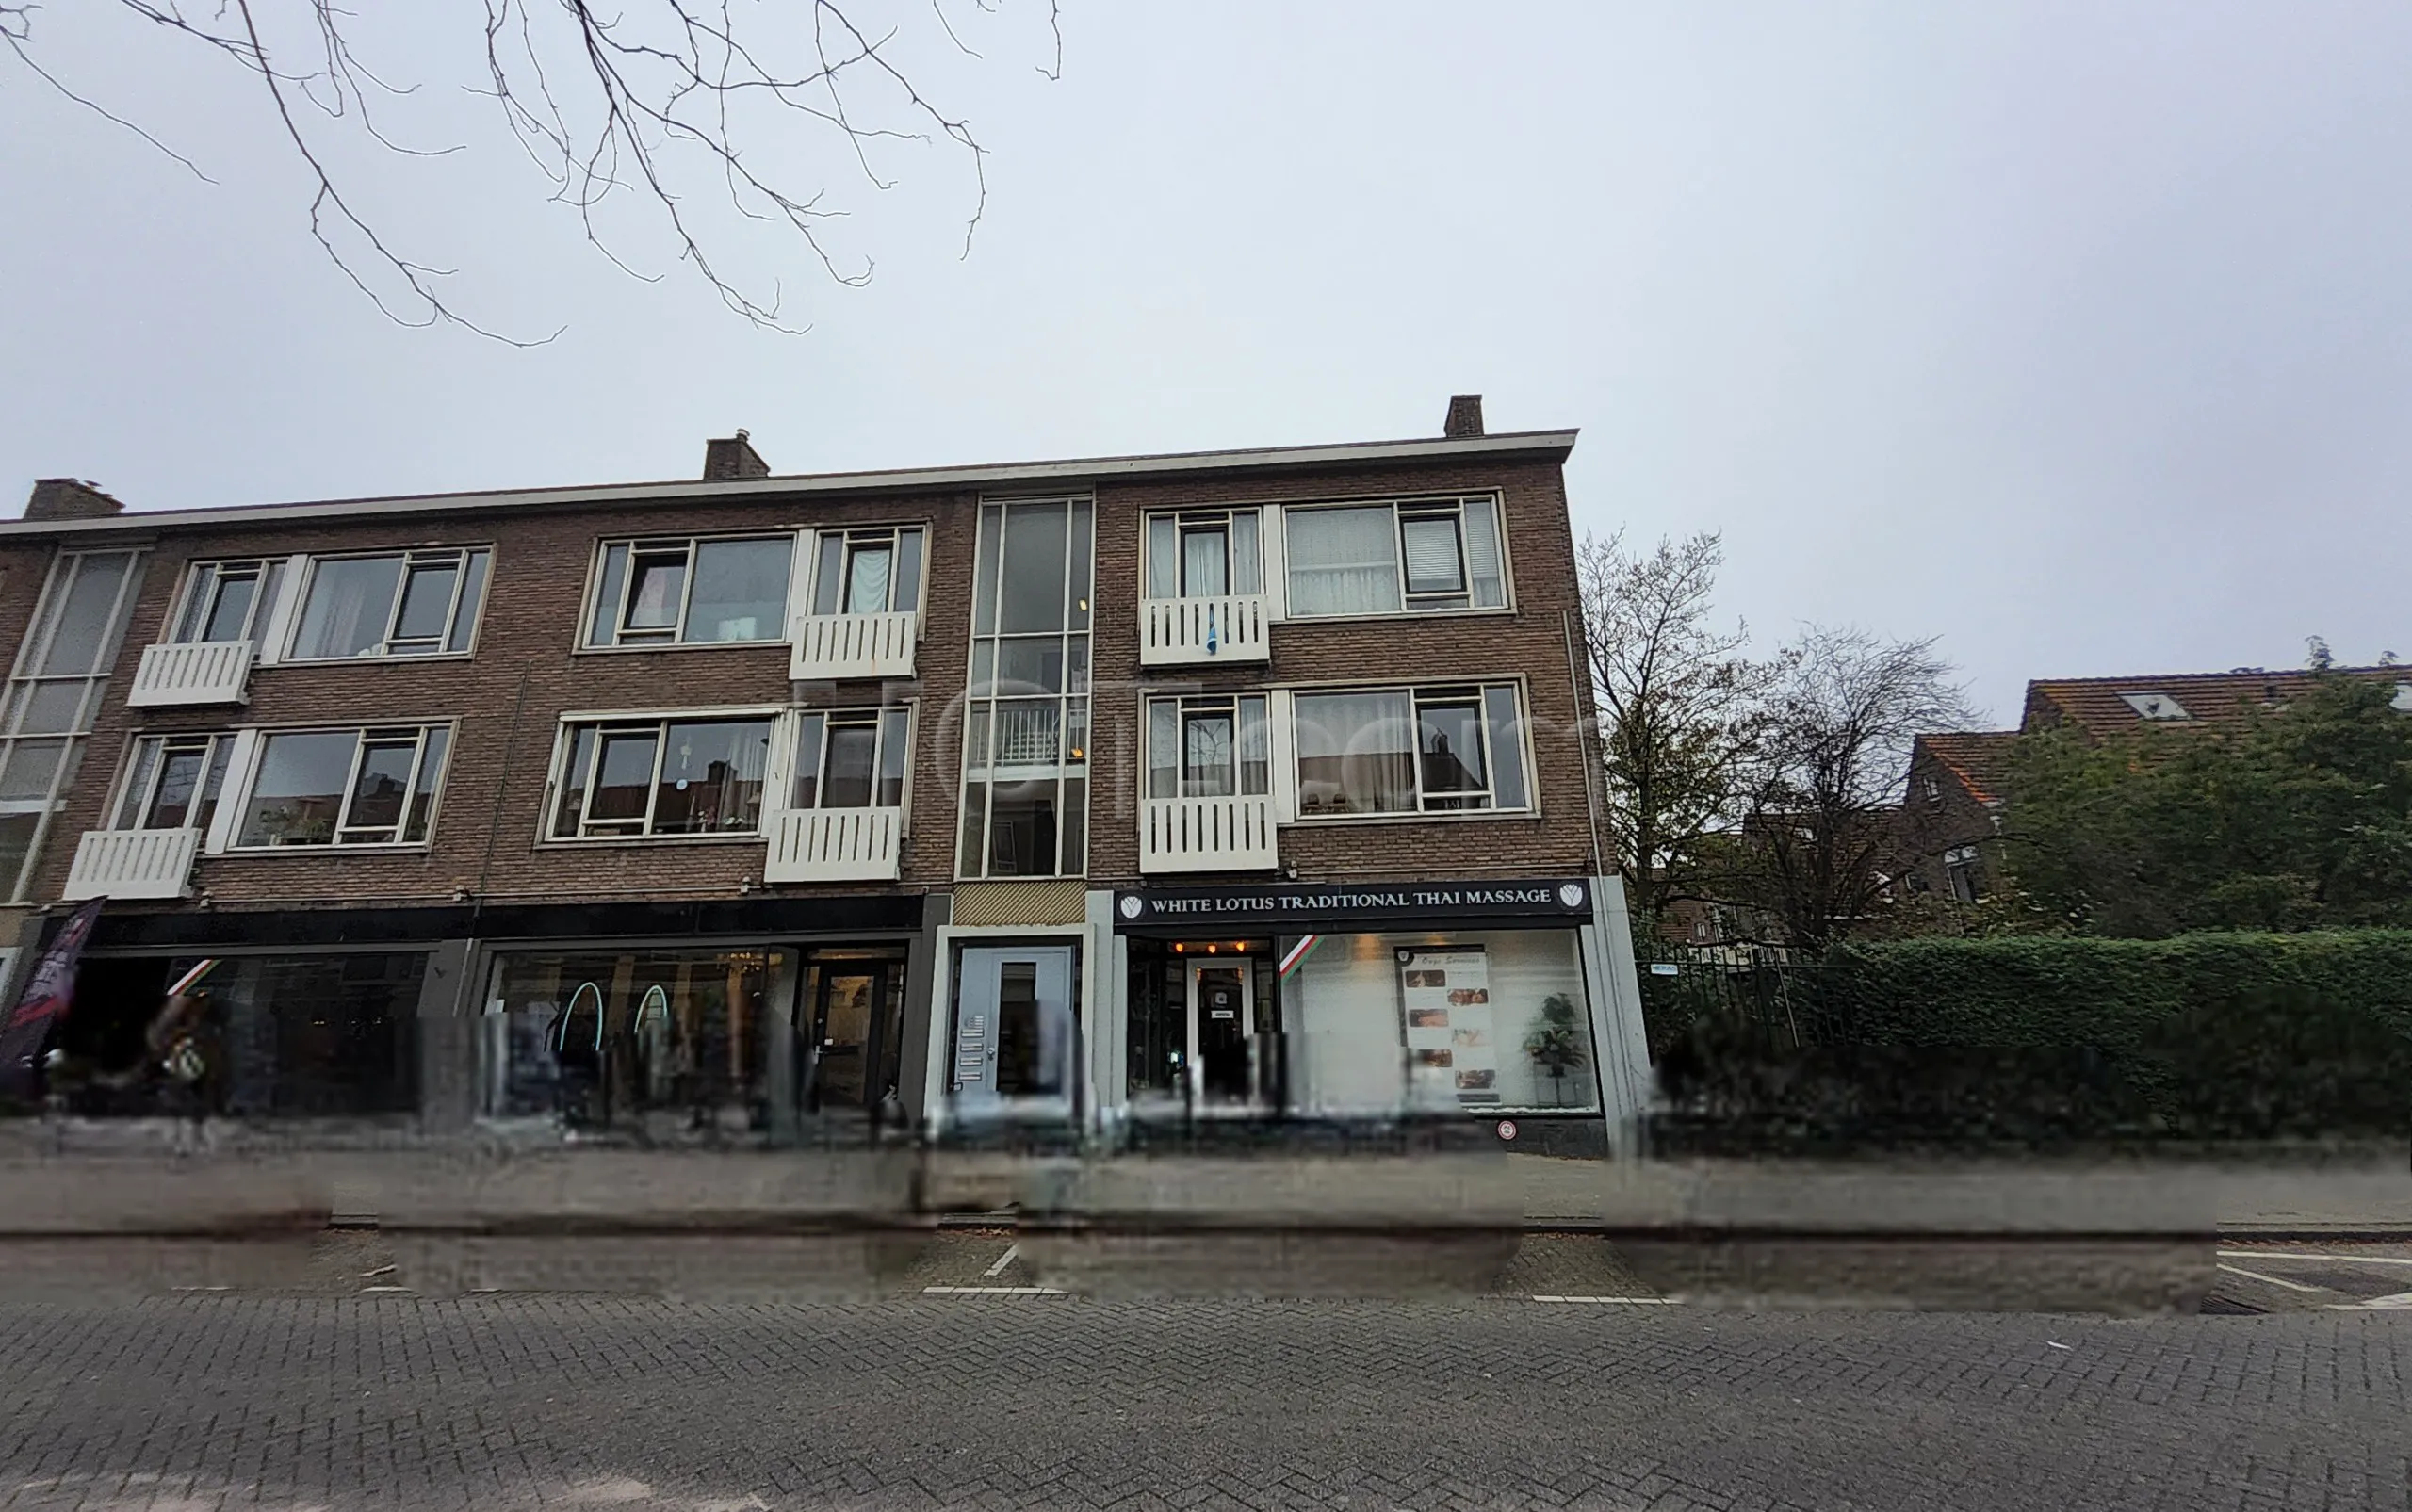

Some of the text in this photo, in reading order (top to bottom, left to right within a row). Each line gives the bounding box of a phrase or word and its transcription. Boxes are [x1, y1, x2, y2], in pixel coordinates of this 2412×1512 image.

[1151, 888, 1552, 913] WHITE LOTUS TRADITIONAL THAI MASSAGE
